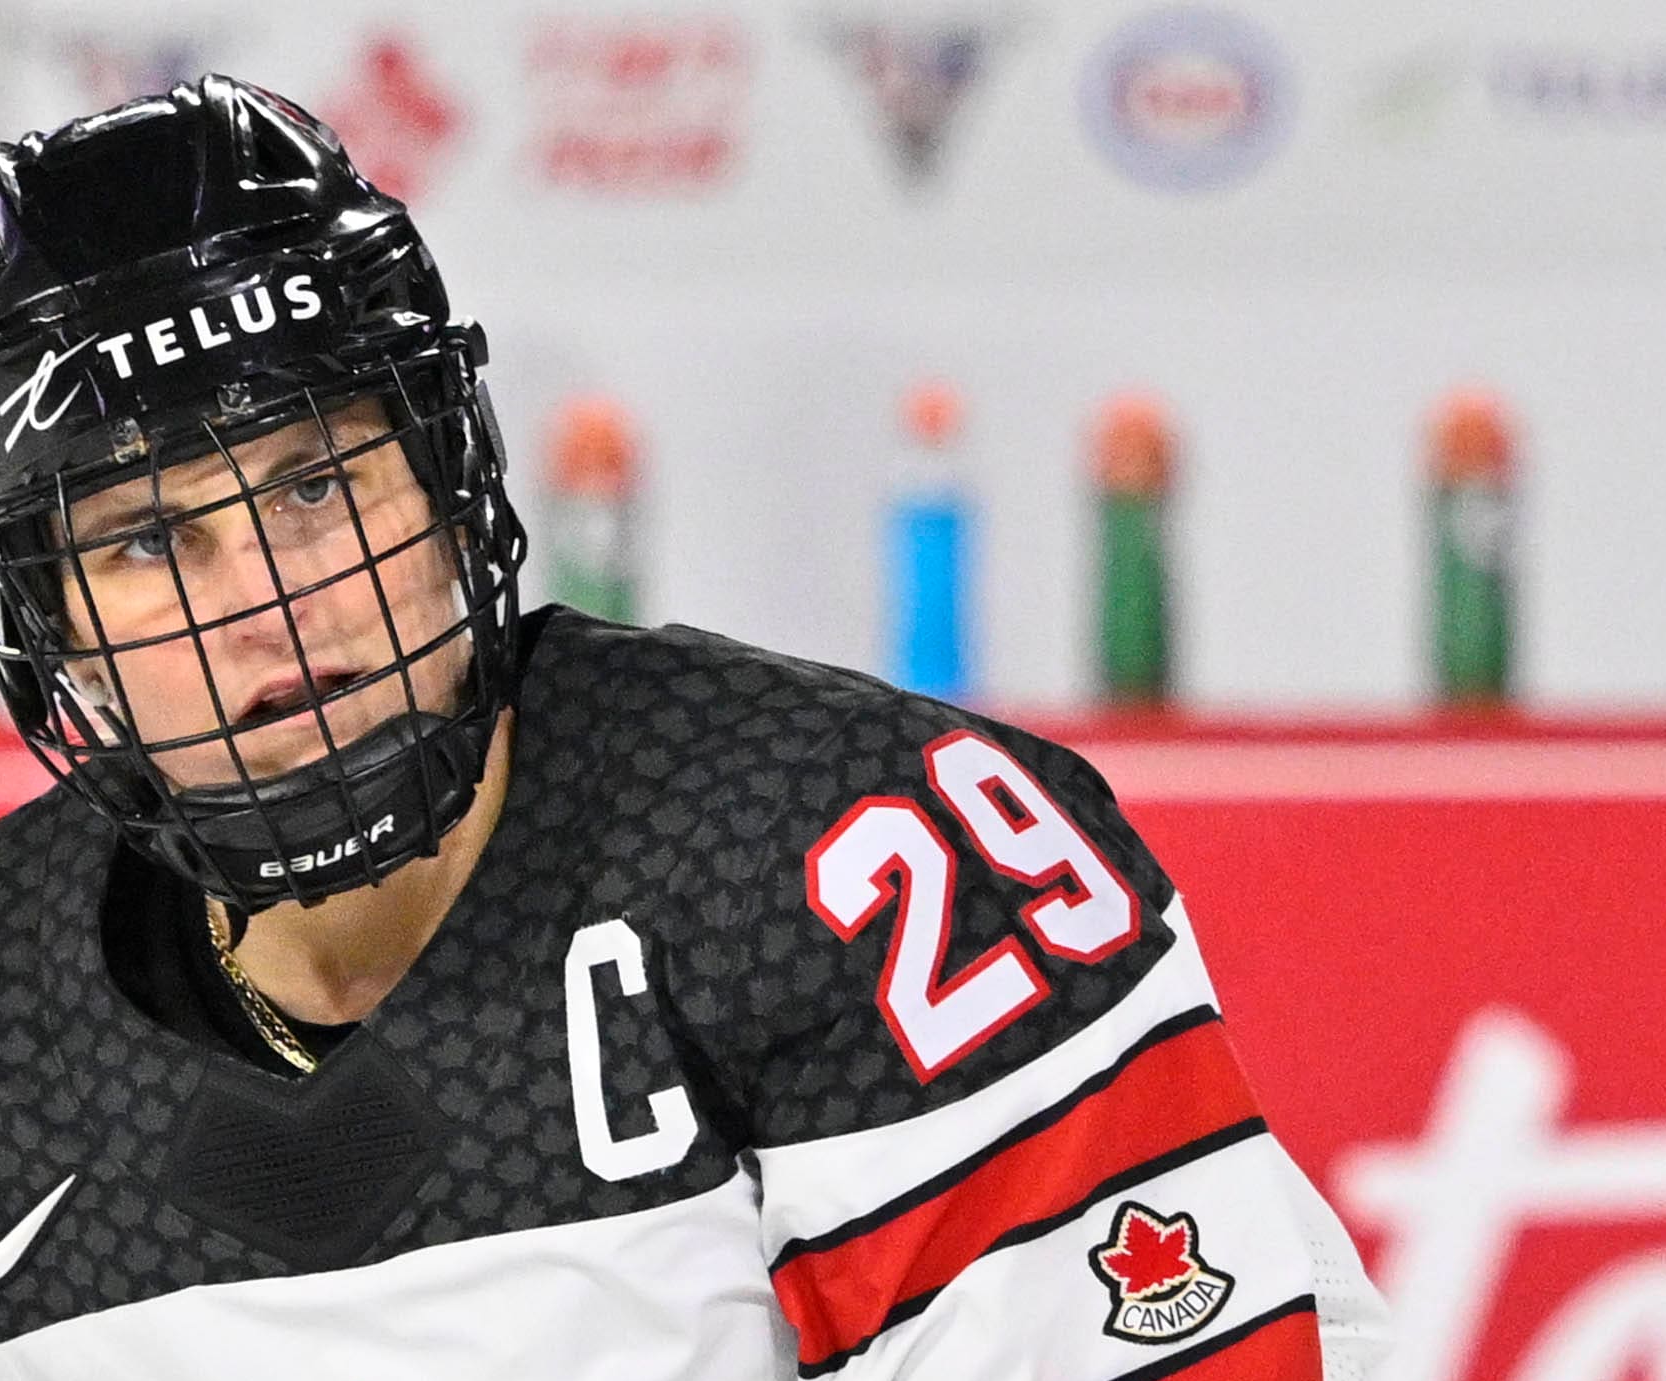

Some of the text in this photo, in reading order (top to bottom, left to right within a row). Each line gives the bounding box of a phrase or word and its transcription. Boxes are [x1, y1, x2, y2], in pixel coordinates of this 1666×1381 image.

[97, 275, 322, 379] TELUS
[260, 814, 394, 878] BAUER
[805, 729, 1140, 1083] 29
[564, 919, 698, 1181] C
[1123, 1280, 1222, 1332] CANADA
